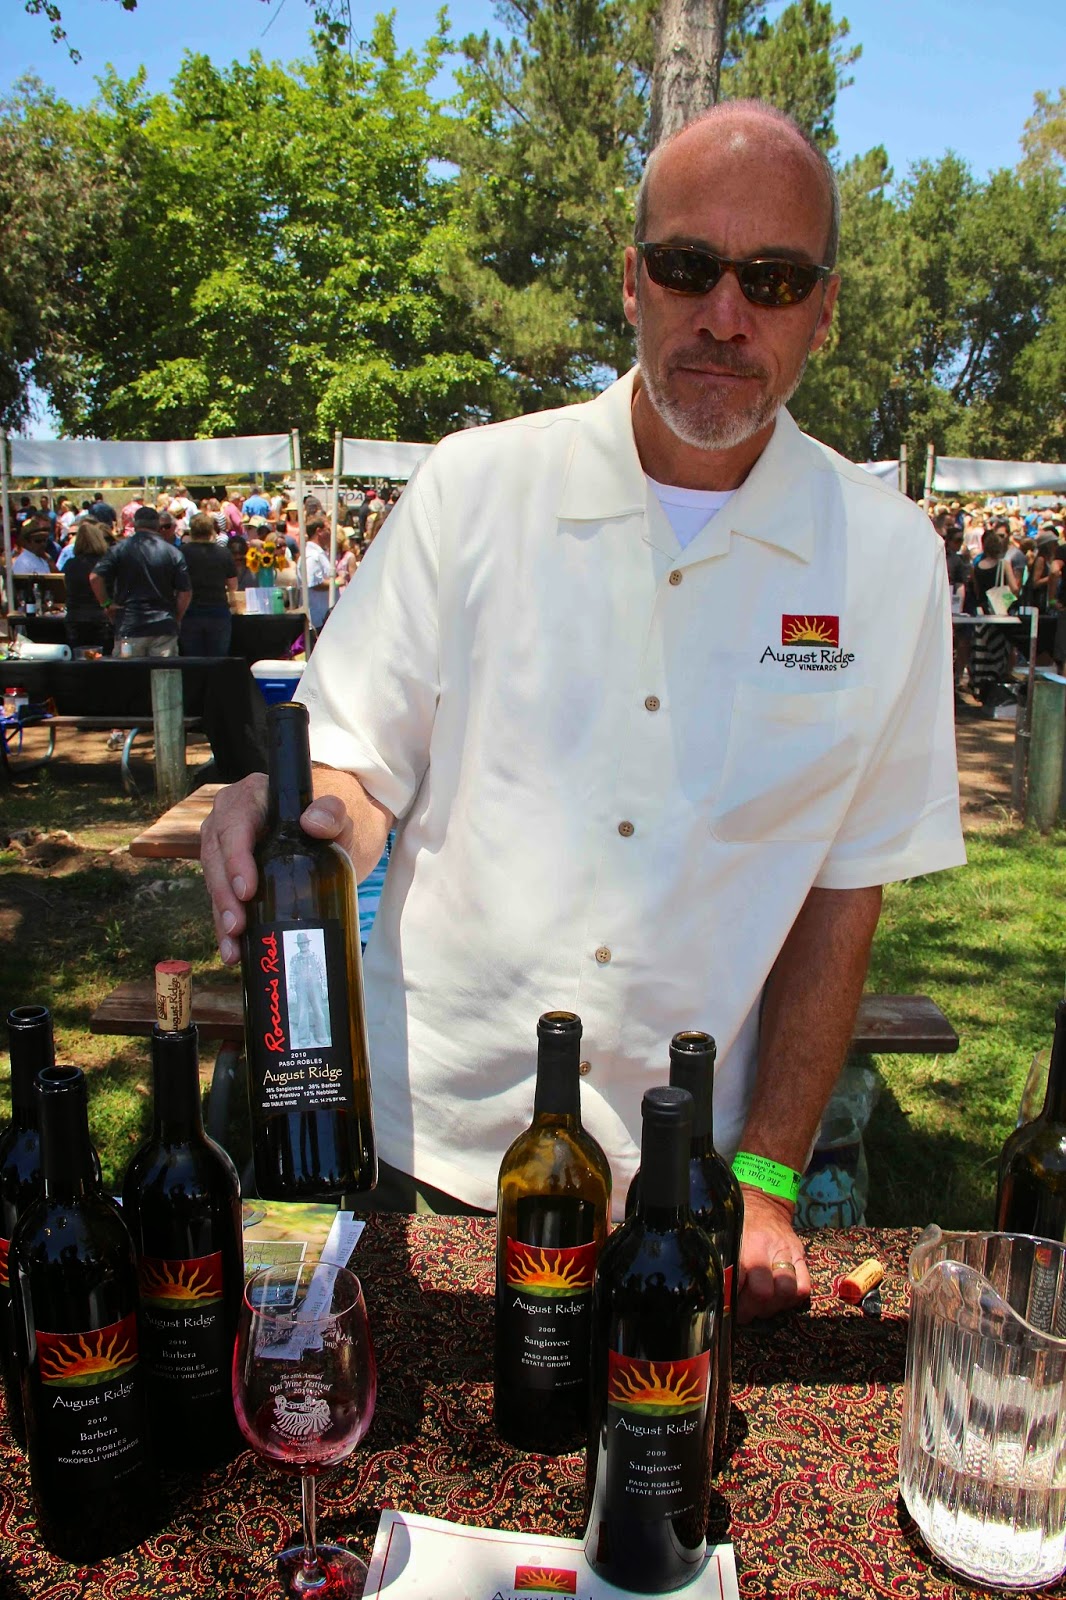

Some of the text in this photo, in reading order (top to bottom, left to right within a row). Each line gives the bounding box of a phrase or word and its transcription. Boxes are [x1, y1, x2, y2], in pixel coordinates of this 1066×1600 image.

[759, 645, 855, 668] August Ridge
[260, 931, 285, 1052] Rocco's Red
[171, 1006, 181, 1031] ugust
[262, 1063, 343, 1086] August Ridge
[749, 1170, 766, 1181] Ojai
[767, 1177, 780, 1187] The
[512, 1297, 585, 1315] August Ridge
[184, 1314, 216, 1328] Ridge
[524, 1335, 571, 1348] Sangiovese
[162, 1350, 197, 1359] Barbera
[524, 1352, 541, 1360] PASO
[175, 1363, 206, 1372] ROBLES
[521, 1358, 545, 1367] ESTATE
[181, 1367, 219, 1380] VINEYARDS
[283, 1380, 302, 1389] Wine
[303, 1380, 333, 1392] Festival
[52, 1382, 135, 1411] August Ridge
[87, 1416, 108, 1426] 2010
[615, 1417, 698, 1437] August Ridge
[80, 1427, 118, 1441] Barbera
[57, 1438, 140, 1464] KOKOPELLI VINEYARDS
[71, 1437, 127, 1456] PASO ROBLES
[629, 1461, 682, 1474] Sangiovese
[628, 1479, 680, 1488] PASO ROBLES
[625, 1486, 683, 1496] ESTATE GROWN
